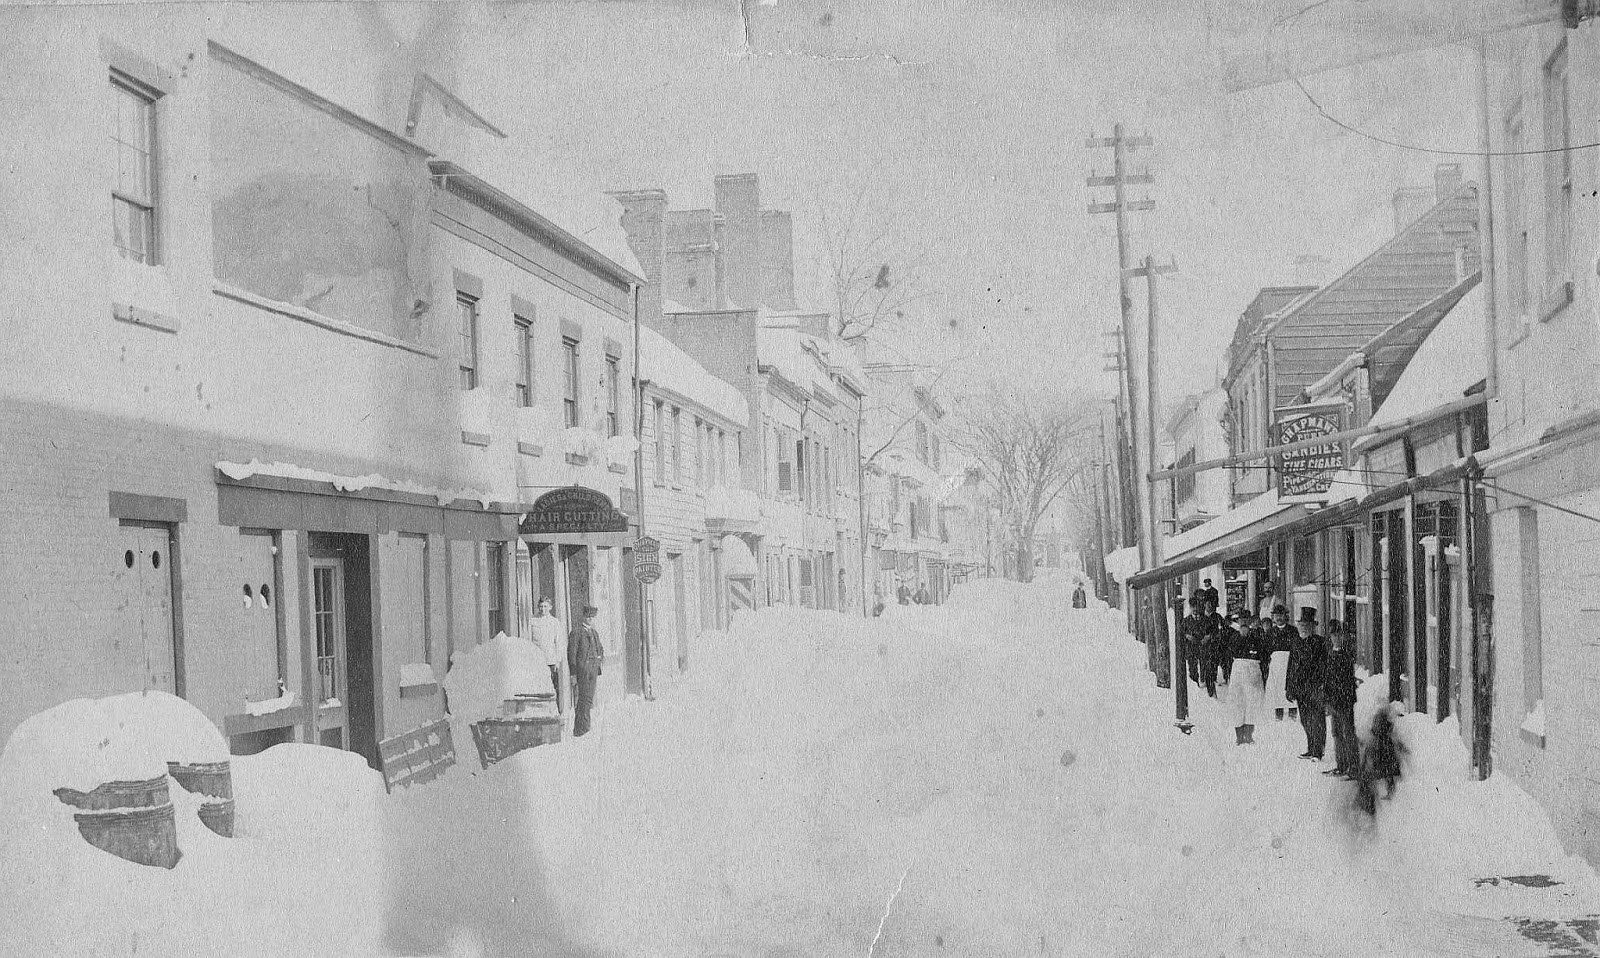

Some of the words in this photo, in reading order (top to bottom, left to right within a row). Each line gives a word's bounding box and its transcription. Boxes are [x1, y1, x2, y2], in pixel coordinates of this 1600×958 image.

[1281, 441, 1342, 460] CANDIES
[1283, 460, 1306, 468] FINE
[528, 512, 561, 523] HAIR
[636, 553, 658, 563] SIGN
